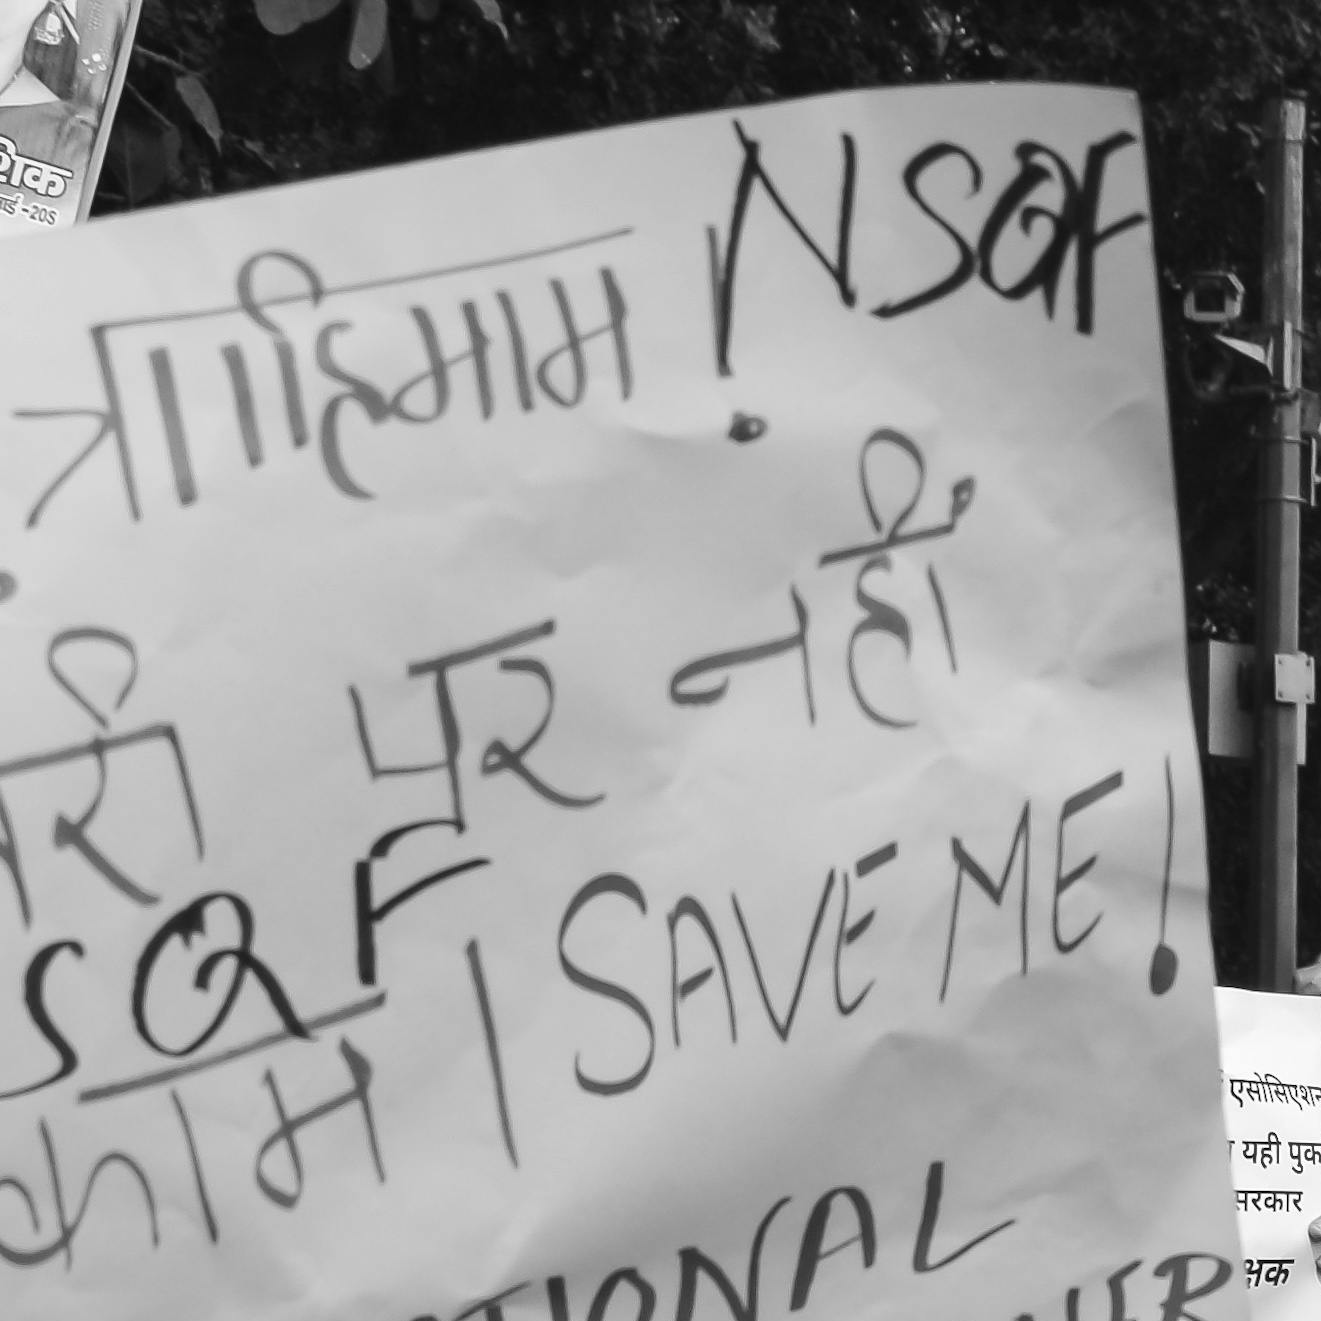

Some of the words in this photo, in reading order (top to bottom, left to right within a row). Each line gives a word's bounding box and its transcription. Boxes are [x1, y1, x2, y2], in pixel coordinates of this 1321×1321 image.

[712, 120, 1148, 378] NSQF
[348, 618, 608, 835] पर
[558, 842, 900, 1098] SAVE
[1242, 1132, 1282, 1169] यही
